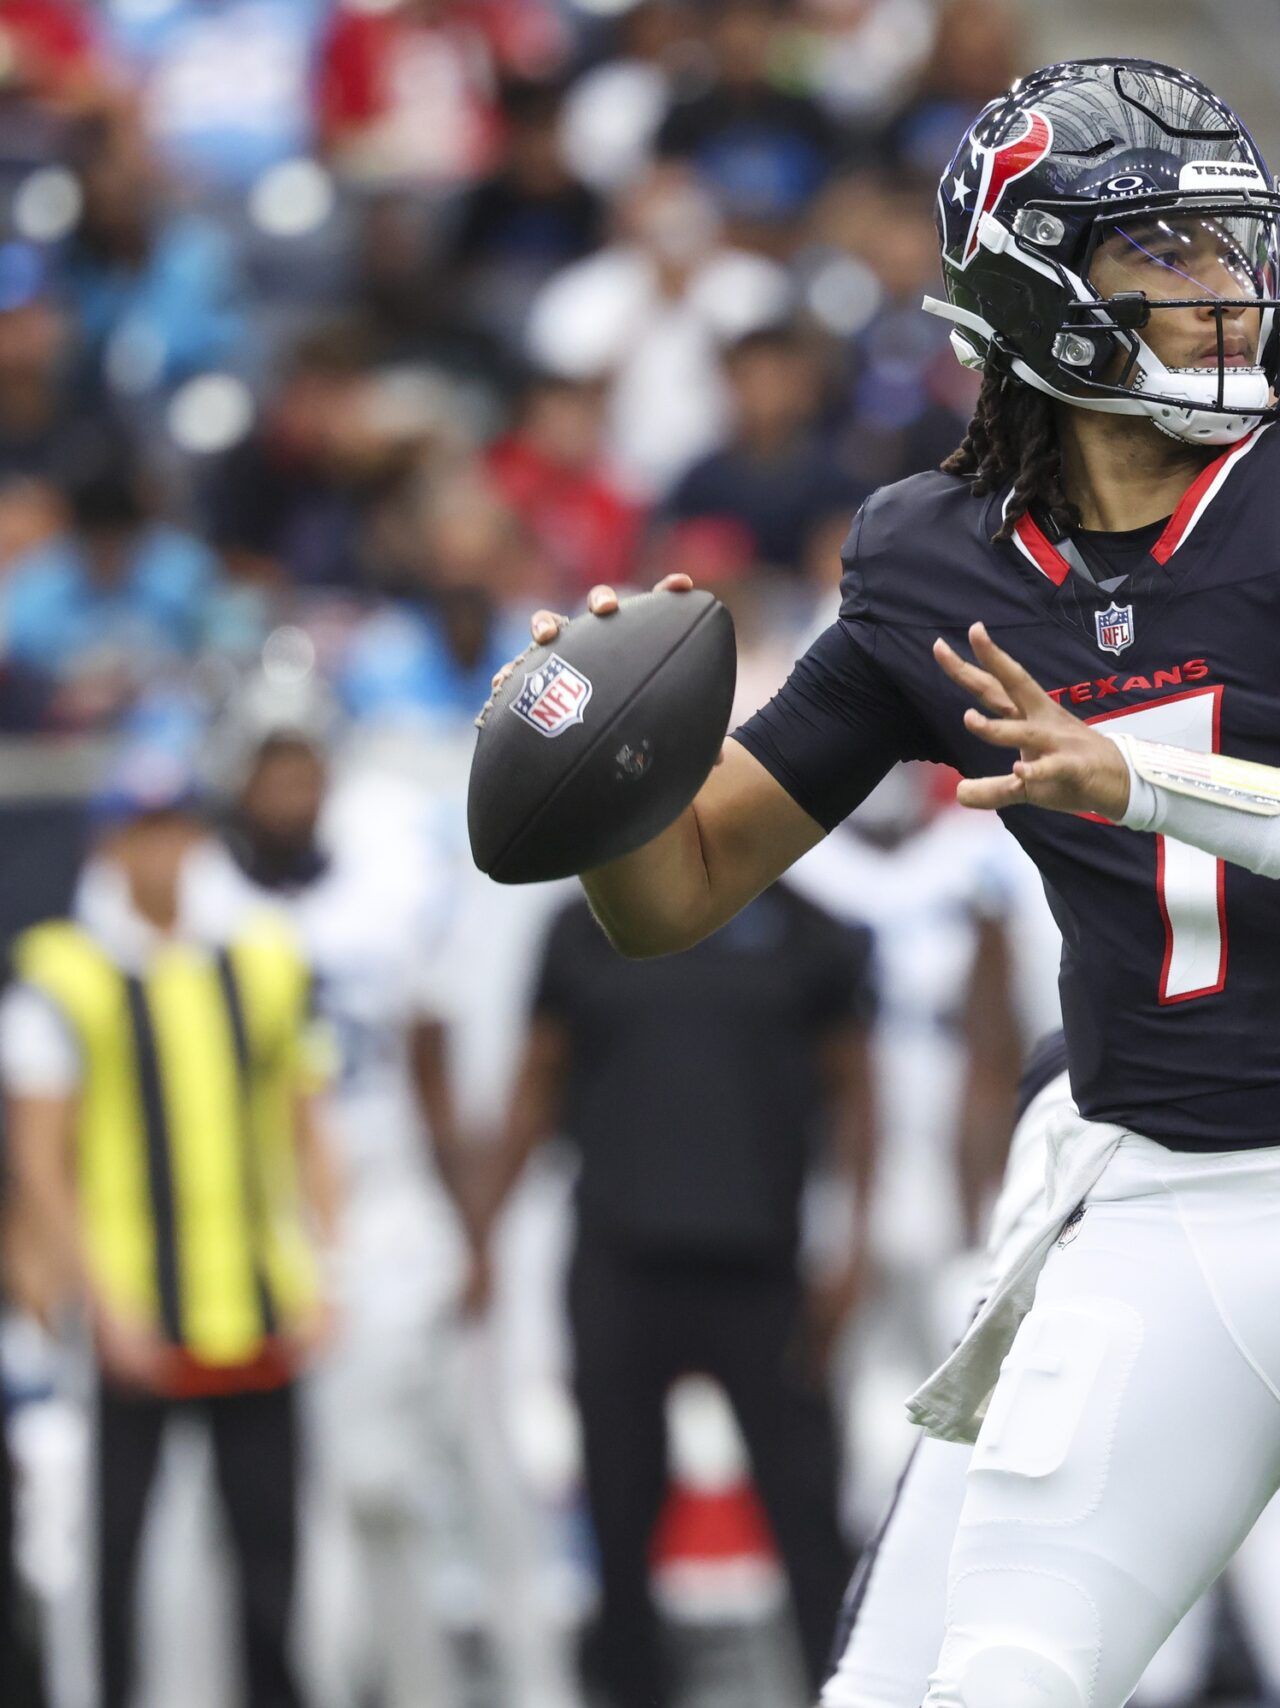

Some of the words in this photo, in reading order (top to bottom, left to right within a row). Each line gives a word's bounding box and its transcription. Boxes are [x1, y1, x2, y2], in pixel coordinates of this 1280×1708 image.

[1192, 165, 1259, 179] TEXANS
[1102, 625, 1129, 646] NFL
[1046, 658, 1209, 705] TEXANS
[530, 677, 584, 728] NFL
